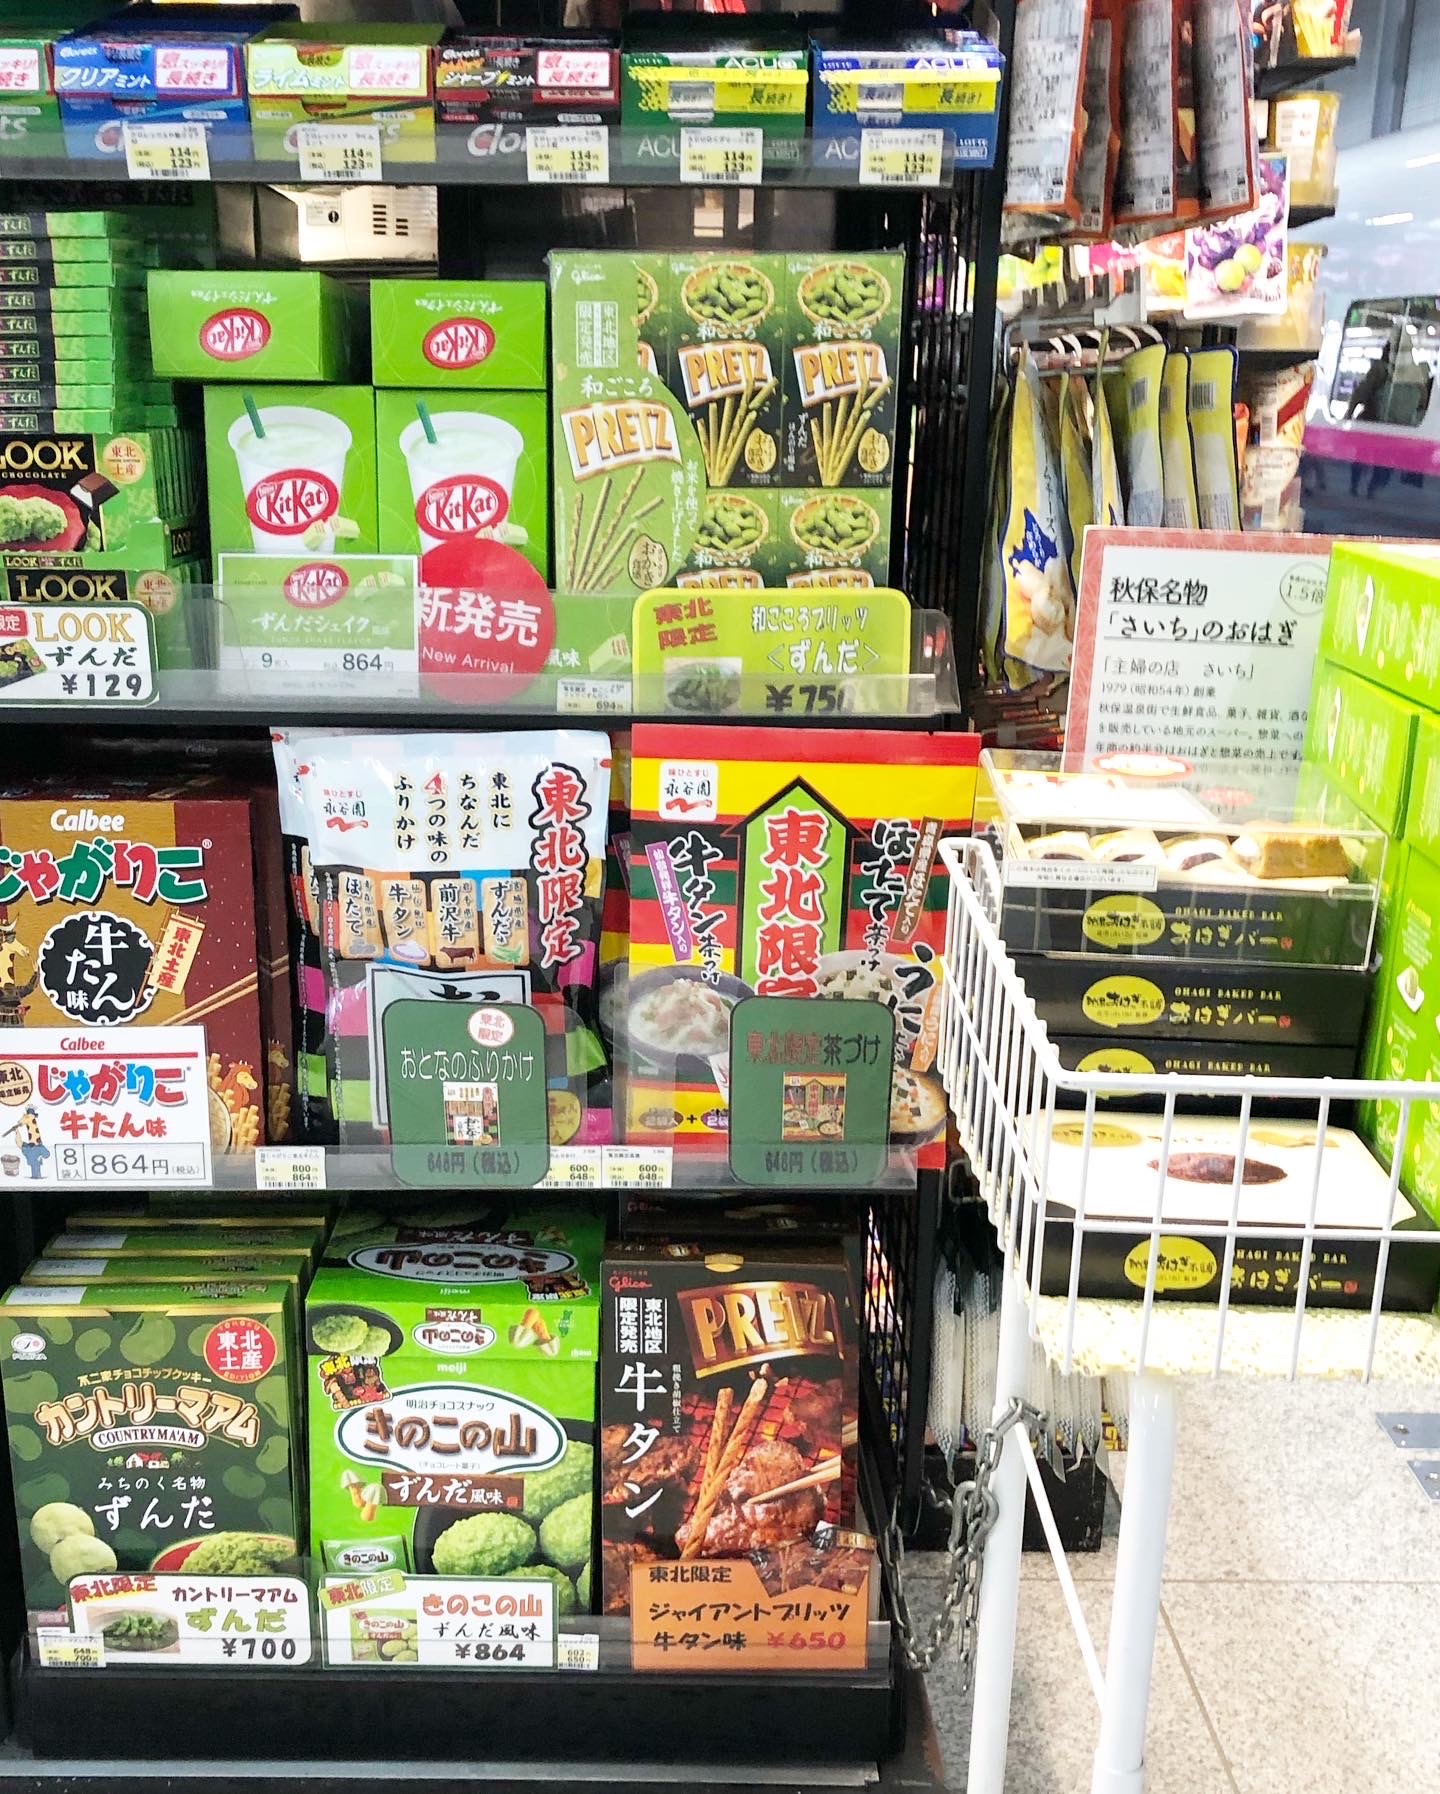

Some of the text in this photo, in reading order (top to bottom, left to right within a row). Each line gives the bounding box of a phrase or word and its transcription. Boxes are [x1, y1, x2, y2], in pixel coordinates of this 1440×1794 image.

[60, 68, 151, 89] クリアミント
[206, 316, 263, 352] KitKat
[428, 326, 483, 362] KitKat
[686, 349, 768, 397] PRETZ
[800, 348, 884, 395] PRETZ
[569, 406, 673, 468] PRETZ
[1, 471, 68, 480] CHOCOLATE
[264, 479, 325, 527] KitKat
[435, 485, 496, 532] KitKat
[6, 556, 38, 568] LOOK
[16, 574, 121, 602] LOOK
[294, 569, 339, 602] KitKat
[1110, 575, 1209, 606] 秋保名物
[418, 583, 542, 647] 新発売
[653, 597, 715, 626] 東北
[32, 612, 135, 642] LOOK
[657, 623, 718, 651] 限定
[1109, 610, 1298, 647] 「さいち」のおはぎ
[45, 646, 138, 667] ずんだ
[422, 646, 515, 675] New Arrival
[61, 673, 143, 698] ¥129
[667, 768, 710, 777] 味ひとすじ
[490, 771, 512, 829] 東北に
[664, 779, 711, 797] 永谷園
[50, 808, 125, 833] Calbee
[322, 798, 366, 818] 永谷園
[394, 775, 416, 850] ふりかけ
[423, 772, 449, 863] 4つの味の
[459, 774, 481, 849] ちなんだ
[537, 770, 585, 967] 東北限定
[345, 876, 363, 936] ほたて
[389, 882, 412, 938] 牛タン
[439, 883, 461, 942] 前沢牛
[1174, 906, 1212, 918] OHAGI
[1261, 910, 1284, 922] BAR
[1169, 921, 1279, 949] おはぎバー
[156, 925, 193, 990] 東北土産
[1174, 986, 1211, 998] OHAGI
[1260, 990, 1282, 1001] BAR
[1168, 1000, 1278, 1027] おはぎバー
[60, 1036, 106, 1051] Calbee
[399, 1047, 535, 1082] おとなのふりかけ
[1165, 1059, 1272, 1074] OHAGI BAKED BAR
[37, 1059, 190, 1107] じゃがりこ
[60, 1111, 168, 1139] 牛たん味
[62, 1148, 78, 1165] 8
[90, 1152, 170, 1175] 864円
[1234, 1248, 1348, 1265] HAGI BAR
[619, 1297, 638, 1354] 限定発売
[644, 1298, 663, 1354] 東北地区
[691, 1286, 836, 1361] PRETZ
[216, 1329, 262, 1351] 東北
[218, 1350, 264, 1371] 土産
[437, 1360, 468, 1375] meiji
[77, 1367, 212, 1388] 不二家チョコチップクッキー
[221, 1369, 264, 1383] EDITION
[35, 1382, 260, 1447] カントリーマアム
[405, 1399, 496, 1412] 明治チョコスナック
[97, 1427, 156, 1445] COUNTRY
[363, 1407, 538, 1458] きのこの山
[613, 1361, 669, 1519] 牛タン
[97, 1475, 207, 1491] みちのく名物
[388, 1475, 504, 1505] ずんだ風味
[94, 1496, 217, 1531] ずんだ
[343, 1552, 390, 1565] きのこの山
[69, 1574, 159, 1602] 東北限定
[649, 1565, 732, 1584] 東北限定
[172, 1586, 299, 1604] カントリーマアム
[328, 1576, 395, 1605] 東北限定
[421, 1593, 544, 1618] きのこの山
[649, 1602, 850, 1622] ジャイアントプリッツ
[185, 1607, 288, 1634] ずんだ
[432, 1621, 541, 1640] ずんだ風味
[221, 1637, 297, 1661] ¥700
[454, 1643, 527, 1662] ¥864
[653, 1631, 846, 1651] 牛タン味 ¥650
